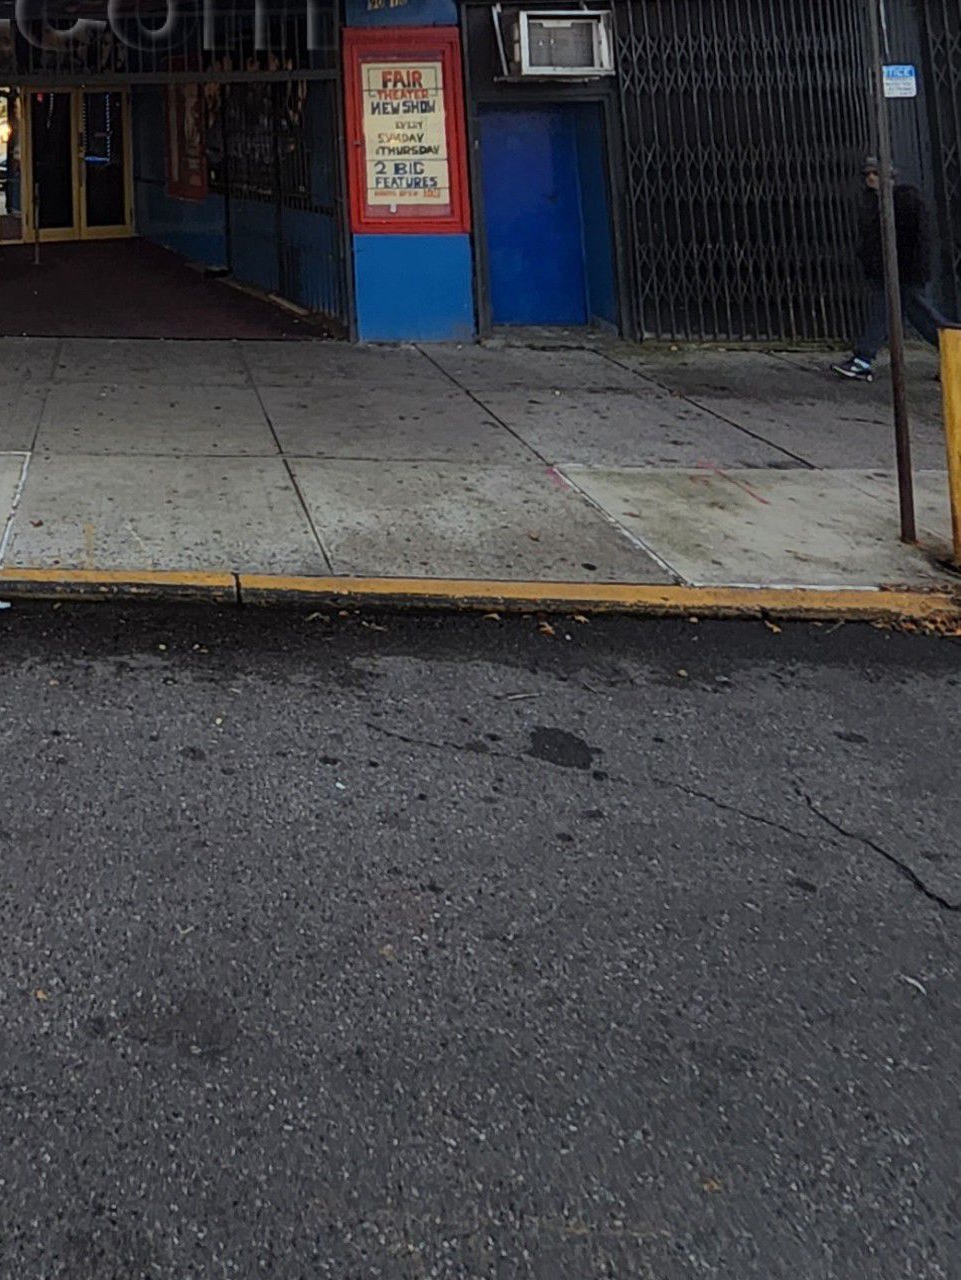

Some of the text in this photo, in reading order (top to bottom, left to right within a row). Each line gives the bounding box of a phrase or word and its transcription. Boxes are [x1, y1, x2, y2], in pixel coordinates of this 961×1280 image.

[381, 69, 423, 89] FAIR
[377, 89, 429, 100] THEATER
[371, 100, 436, 115] NEW SHOW
[378, 133, 425, 144] SUNDAY
[374, 161, 425, 175] 2 BIG
[375, 176, 438, 189] FEATURES
